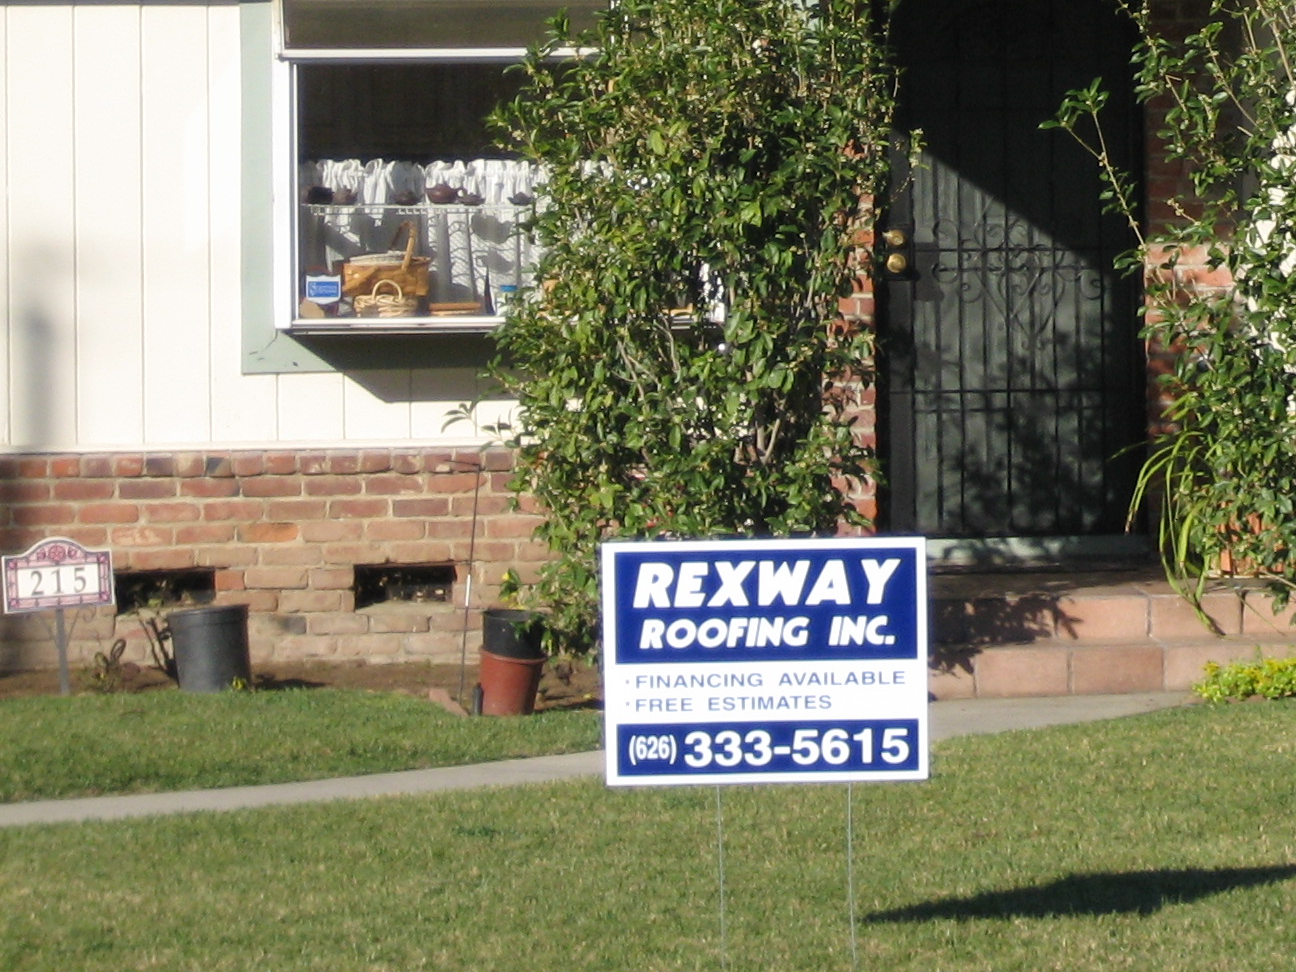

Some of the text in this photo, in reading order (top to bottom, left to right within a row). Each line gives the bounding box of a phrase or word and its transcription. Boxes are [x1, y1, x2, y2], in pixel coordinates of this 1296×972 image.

[31, 567, 87, 596] 215
[633, 559, 901, 608] REXWAY
[639, 615, 896, 649] ROOFING INC.
[635, 671, 906, 689] FINANCING AVAILABLE
[635, 695, 833, 712] FREE ESTIMATES
[628, 728, 910, 767] (626) 333-5615
